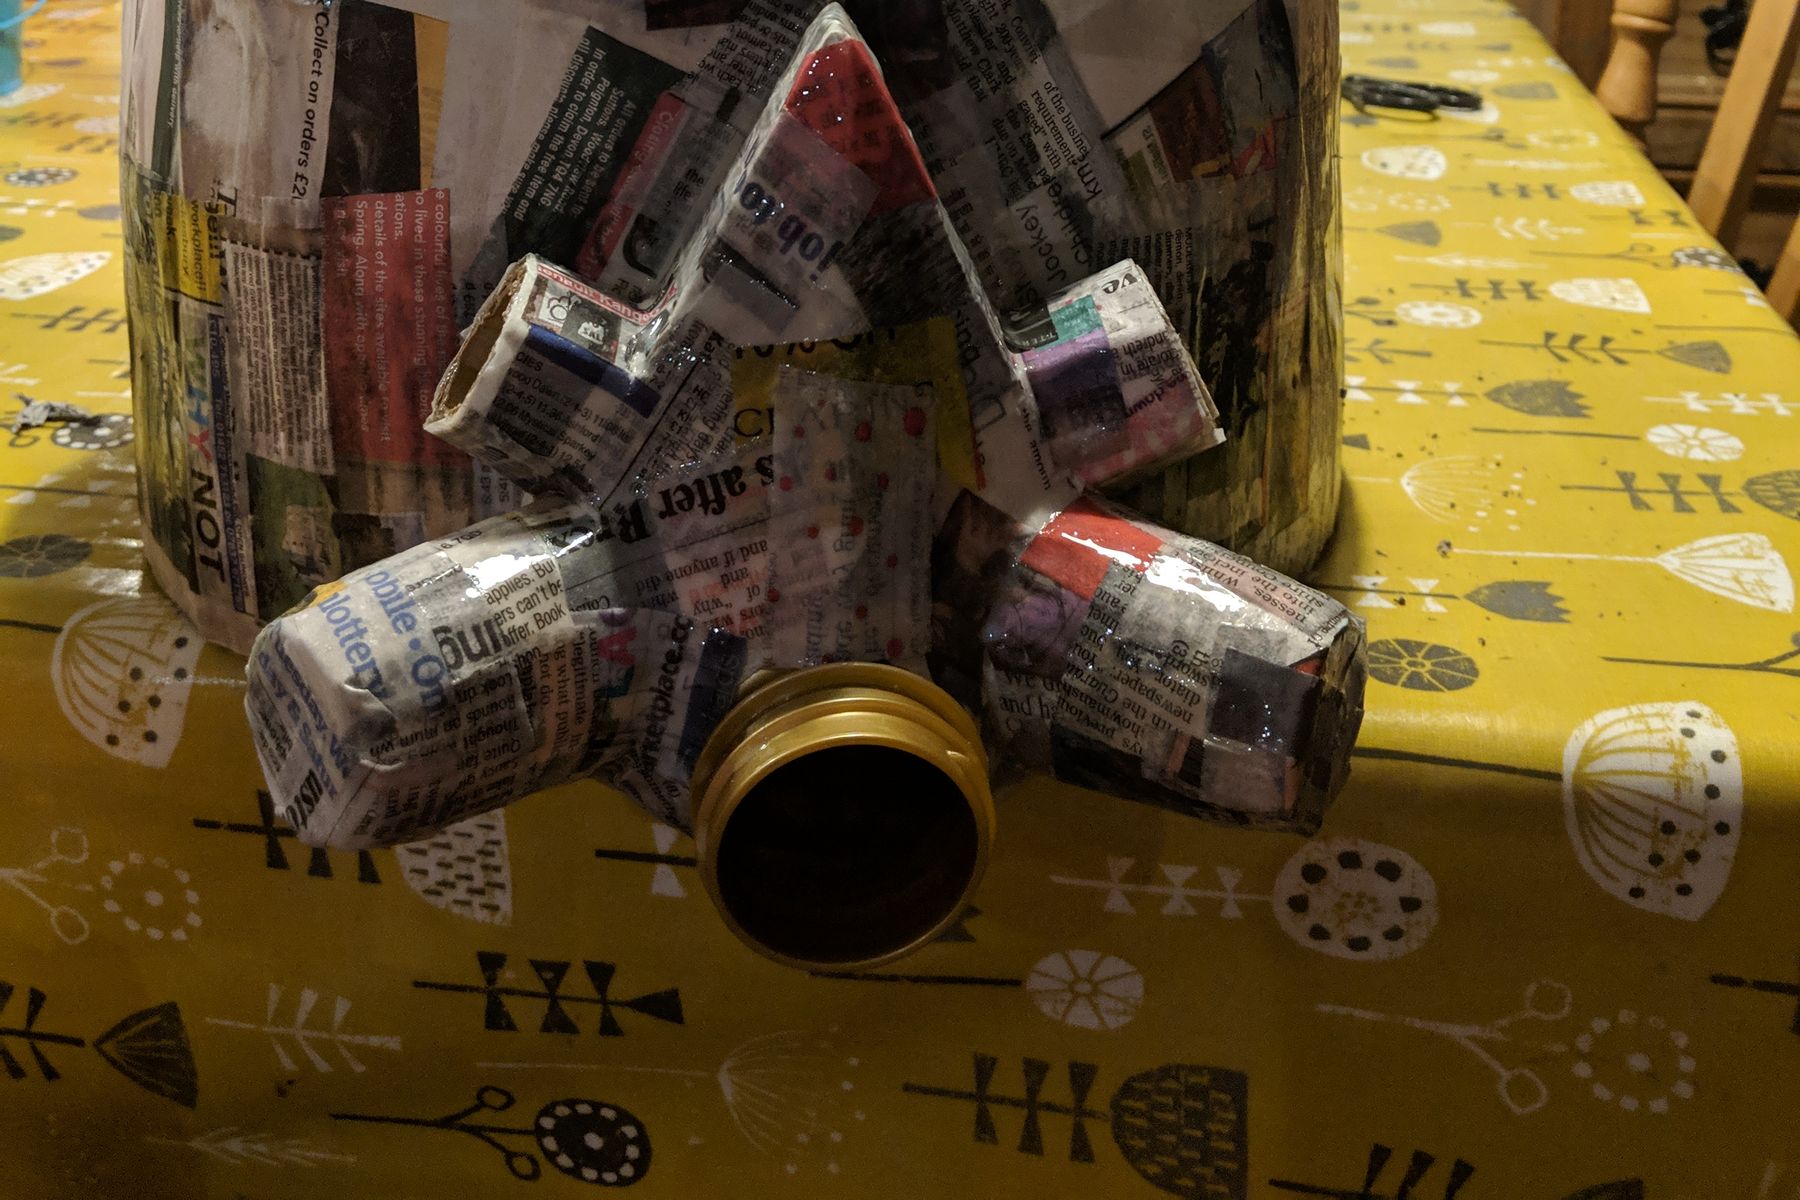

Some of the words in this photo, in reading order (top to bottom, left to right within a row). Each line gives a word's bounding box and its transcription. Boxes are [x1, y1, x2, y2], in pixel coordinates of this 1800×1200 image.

[301, 10, 336, 77] Collect
[591, 46, 607, 61] In
[578, 59, 601, 90] order
[1041, 79, 1058, 97] of
[304, 79, 322, 104] on
[573, 89, 588, 103] to
[578, 74, 612, 127] Paignton,
[1048, 92, 1069, 117] the
[557, 101, 581, 135] claim
[292, 107, 323, 168] orders
[547, 132, 566, 154] the
[536, 150, 558, 176] free
[1038, 140, 1064, 171] with
[524, 172, 545, 200] item
[372, 200, 387, 247] details
[511, 197, 531, 221] and
[350, 199, 368, 250] Spring.
[411, 208, 428, 243] lived
[432, 203, 449, 265] colourful
[413, 247, 427, 260] in
[1011, 199, 1073, 286] Jockey
[374, 250, 387, 266] of
[352, 254, 368, 296] Along
[373, 269, 386, 292] the
[412, 264, 427, 303] these
[374, 296, 387, 328] sites
[411, 305, 428, 366] stunning
[658, 474, 746, 521] after
[192, 468, 222, 578] NOT
[721, 549, 736, 567] if
[738, 539, 769, 561] and
[662, 554, 720, 583] anyone
[719, 566, 750, 588] and
[531, 600, 566, 630] Book
[1118, 694, 1149, 721] the
